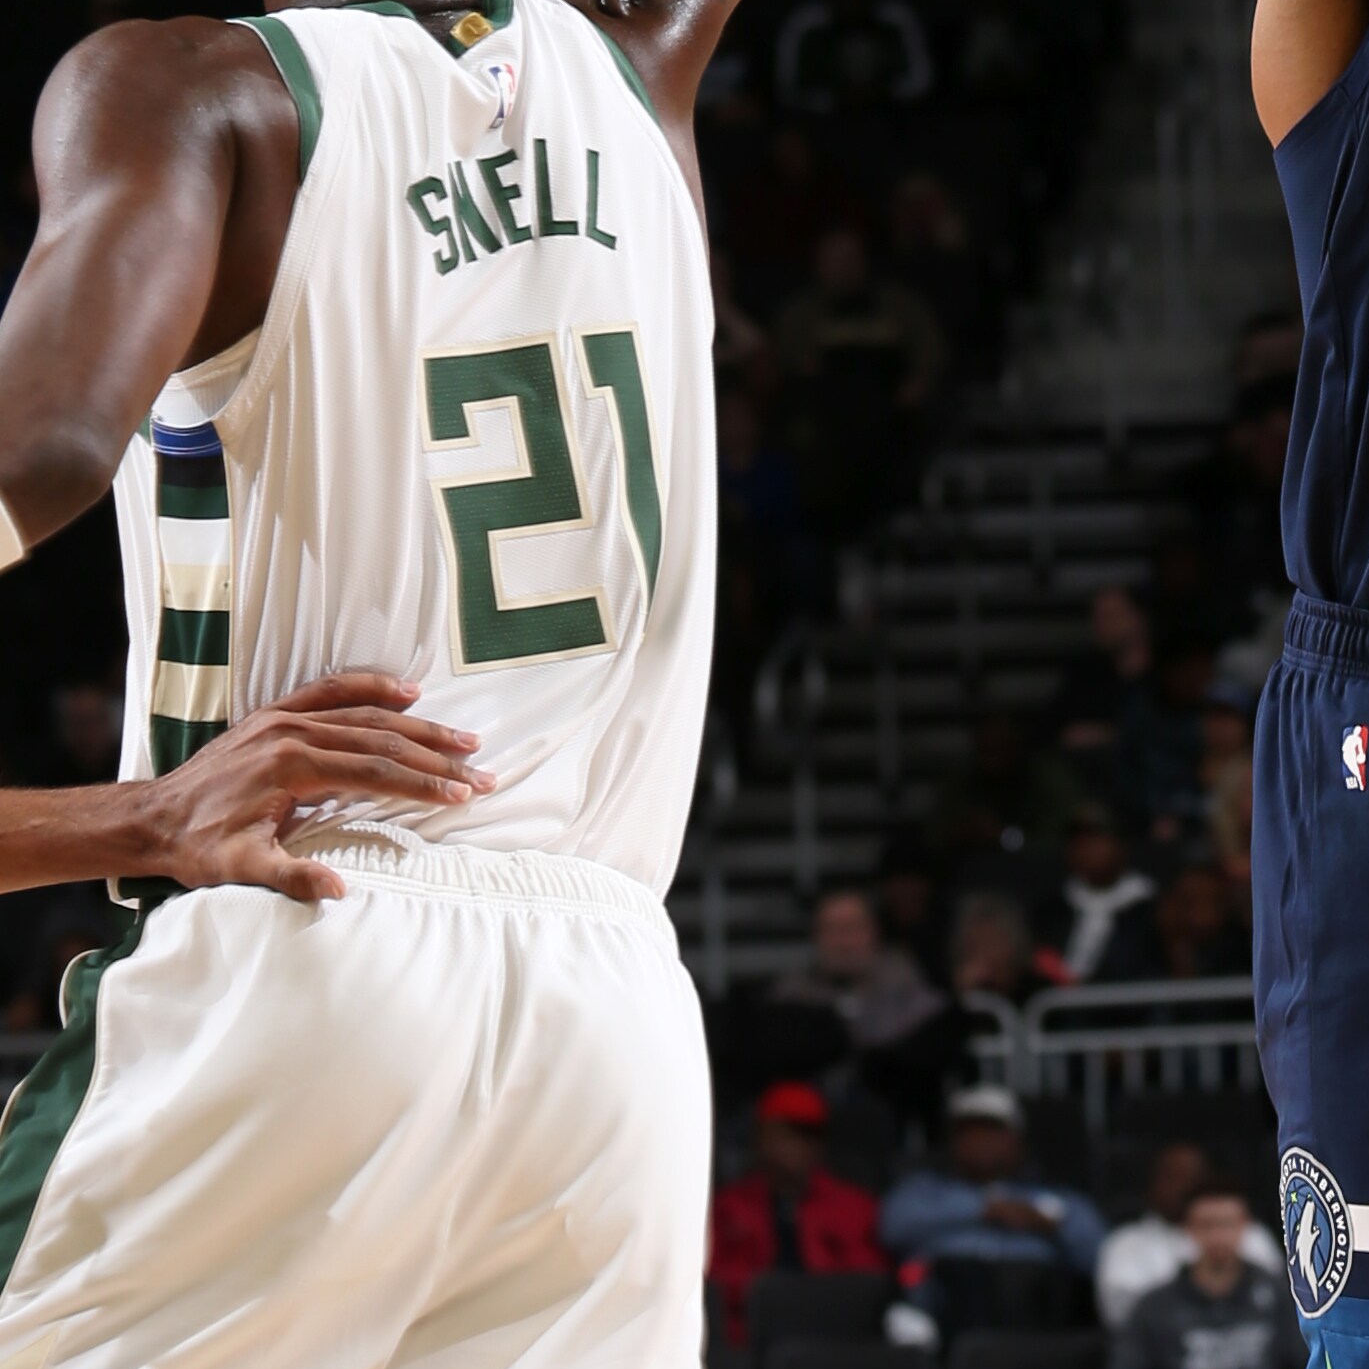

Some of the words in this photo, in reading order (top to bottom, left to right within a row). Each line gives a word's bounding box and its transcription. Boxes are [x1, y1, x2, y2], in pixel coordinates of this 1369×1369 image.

[405, 138, 618, 277] SNELL
[420, 321, 666, 676] 21
[1299, 1158, 1348, 1294] TIMBERWOLVES
